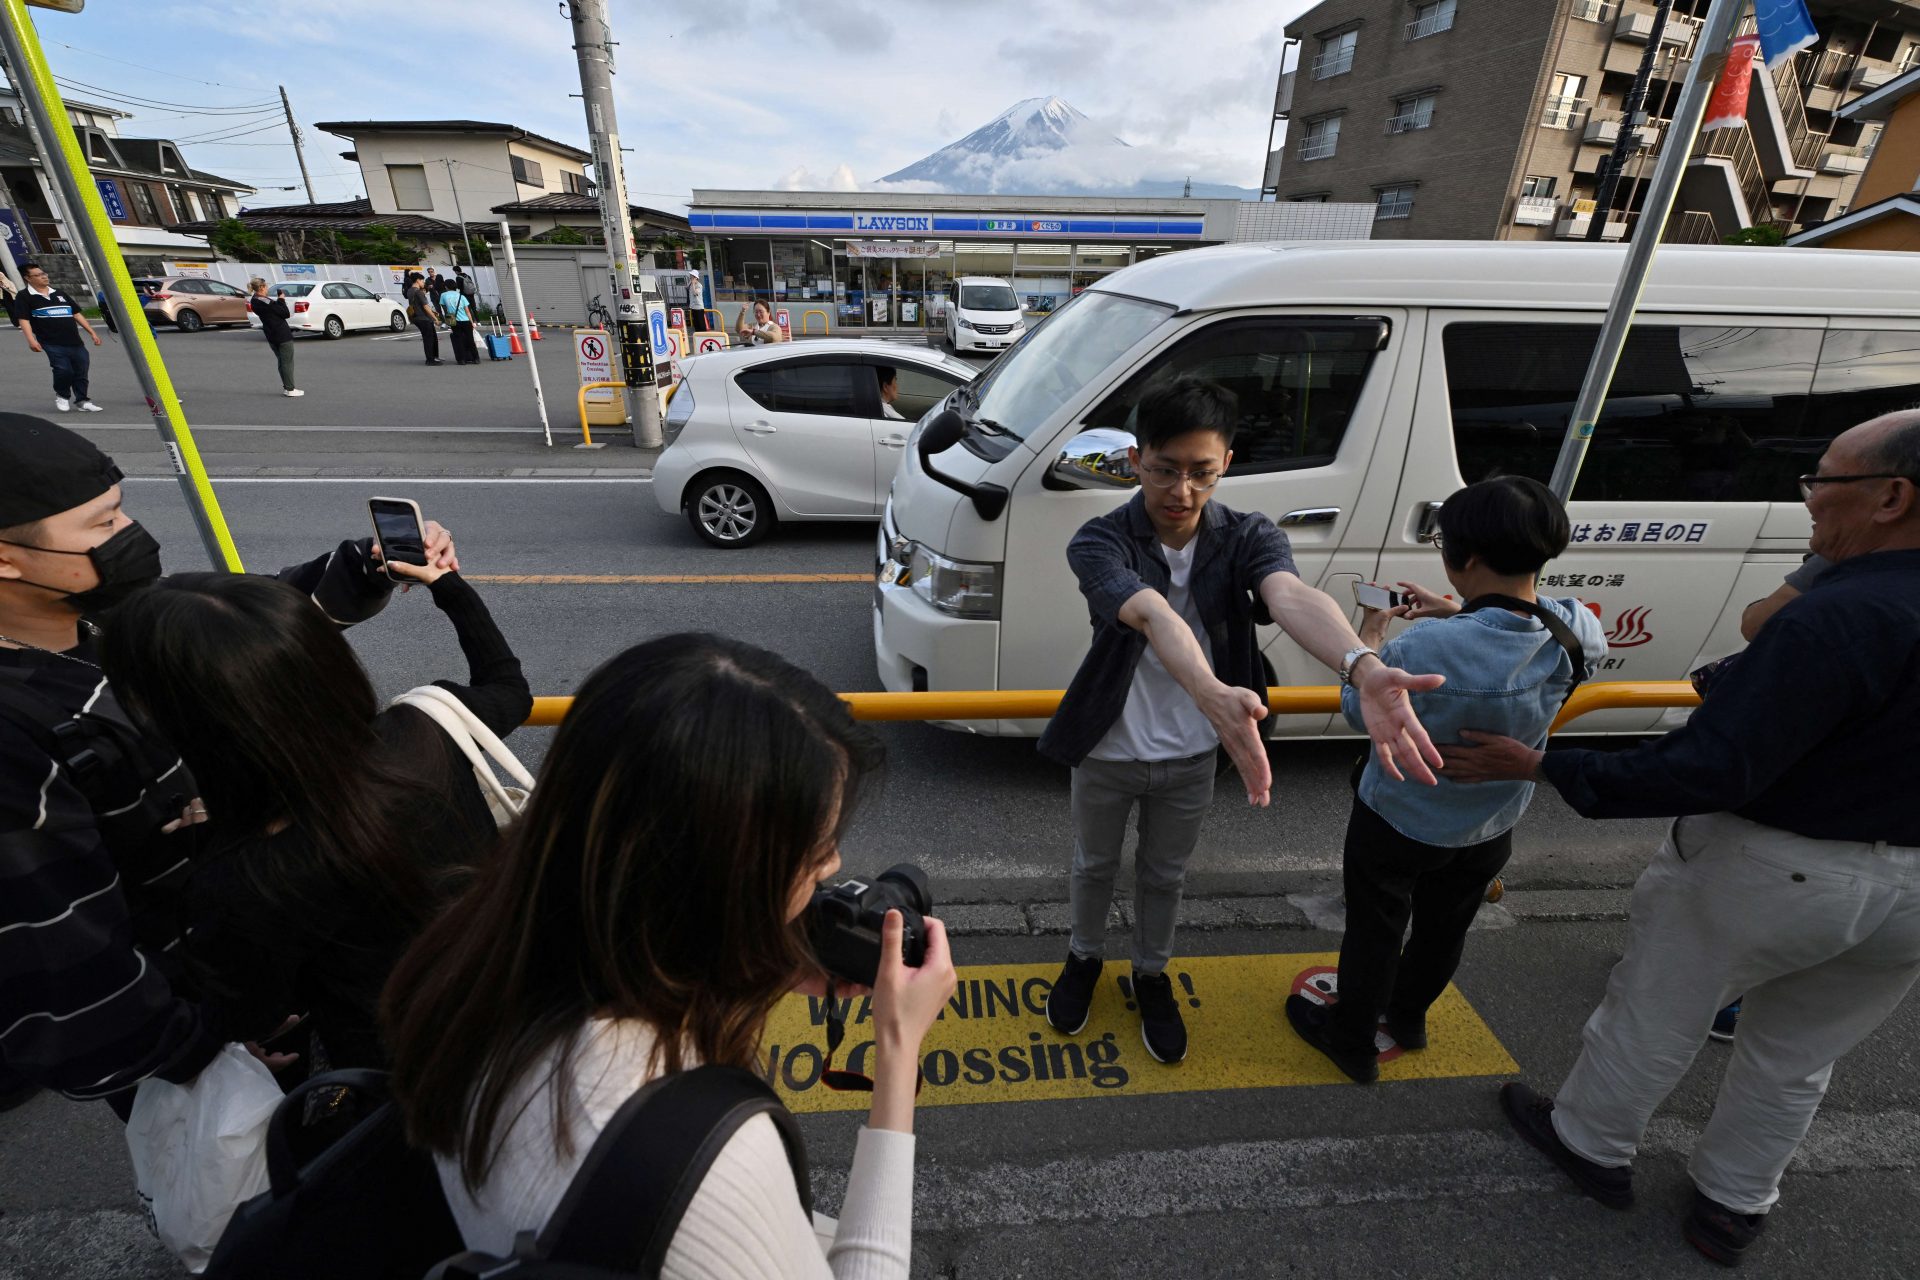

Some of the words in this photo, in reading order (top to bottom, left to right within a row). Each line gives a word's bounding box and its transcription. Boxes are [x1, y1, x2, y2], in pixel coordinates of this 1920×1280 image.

[858, 217, 929, 231] LAWSON
[997, 221, 1013, 230] 野菜
[1041, 221, 1060, 230] くだもの
[1570, 522, 1708, 543] はお風呂の日
[1597, 655, 1625, 669] RI
[808, 976, 1050, 1025] WNING
[846, 1032, 1129, 1089] Cossing
